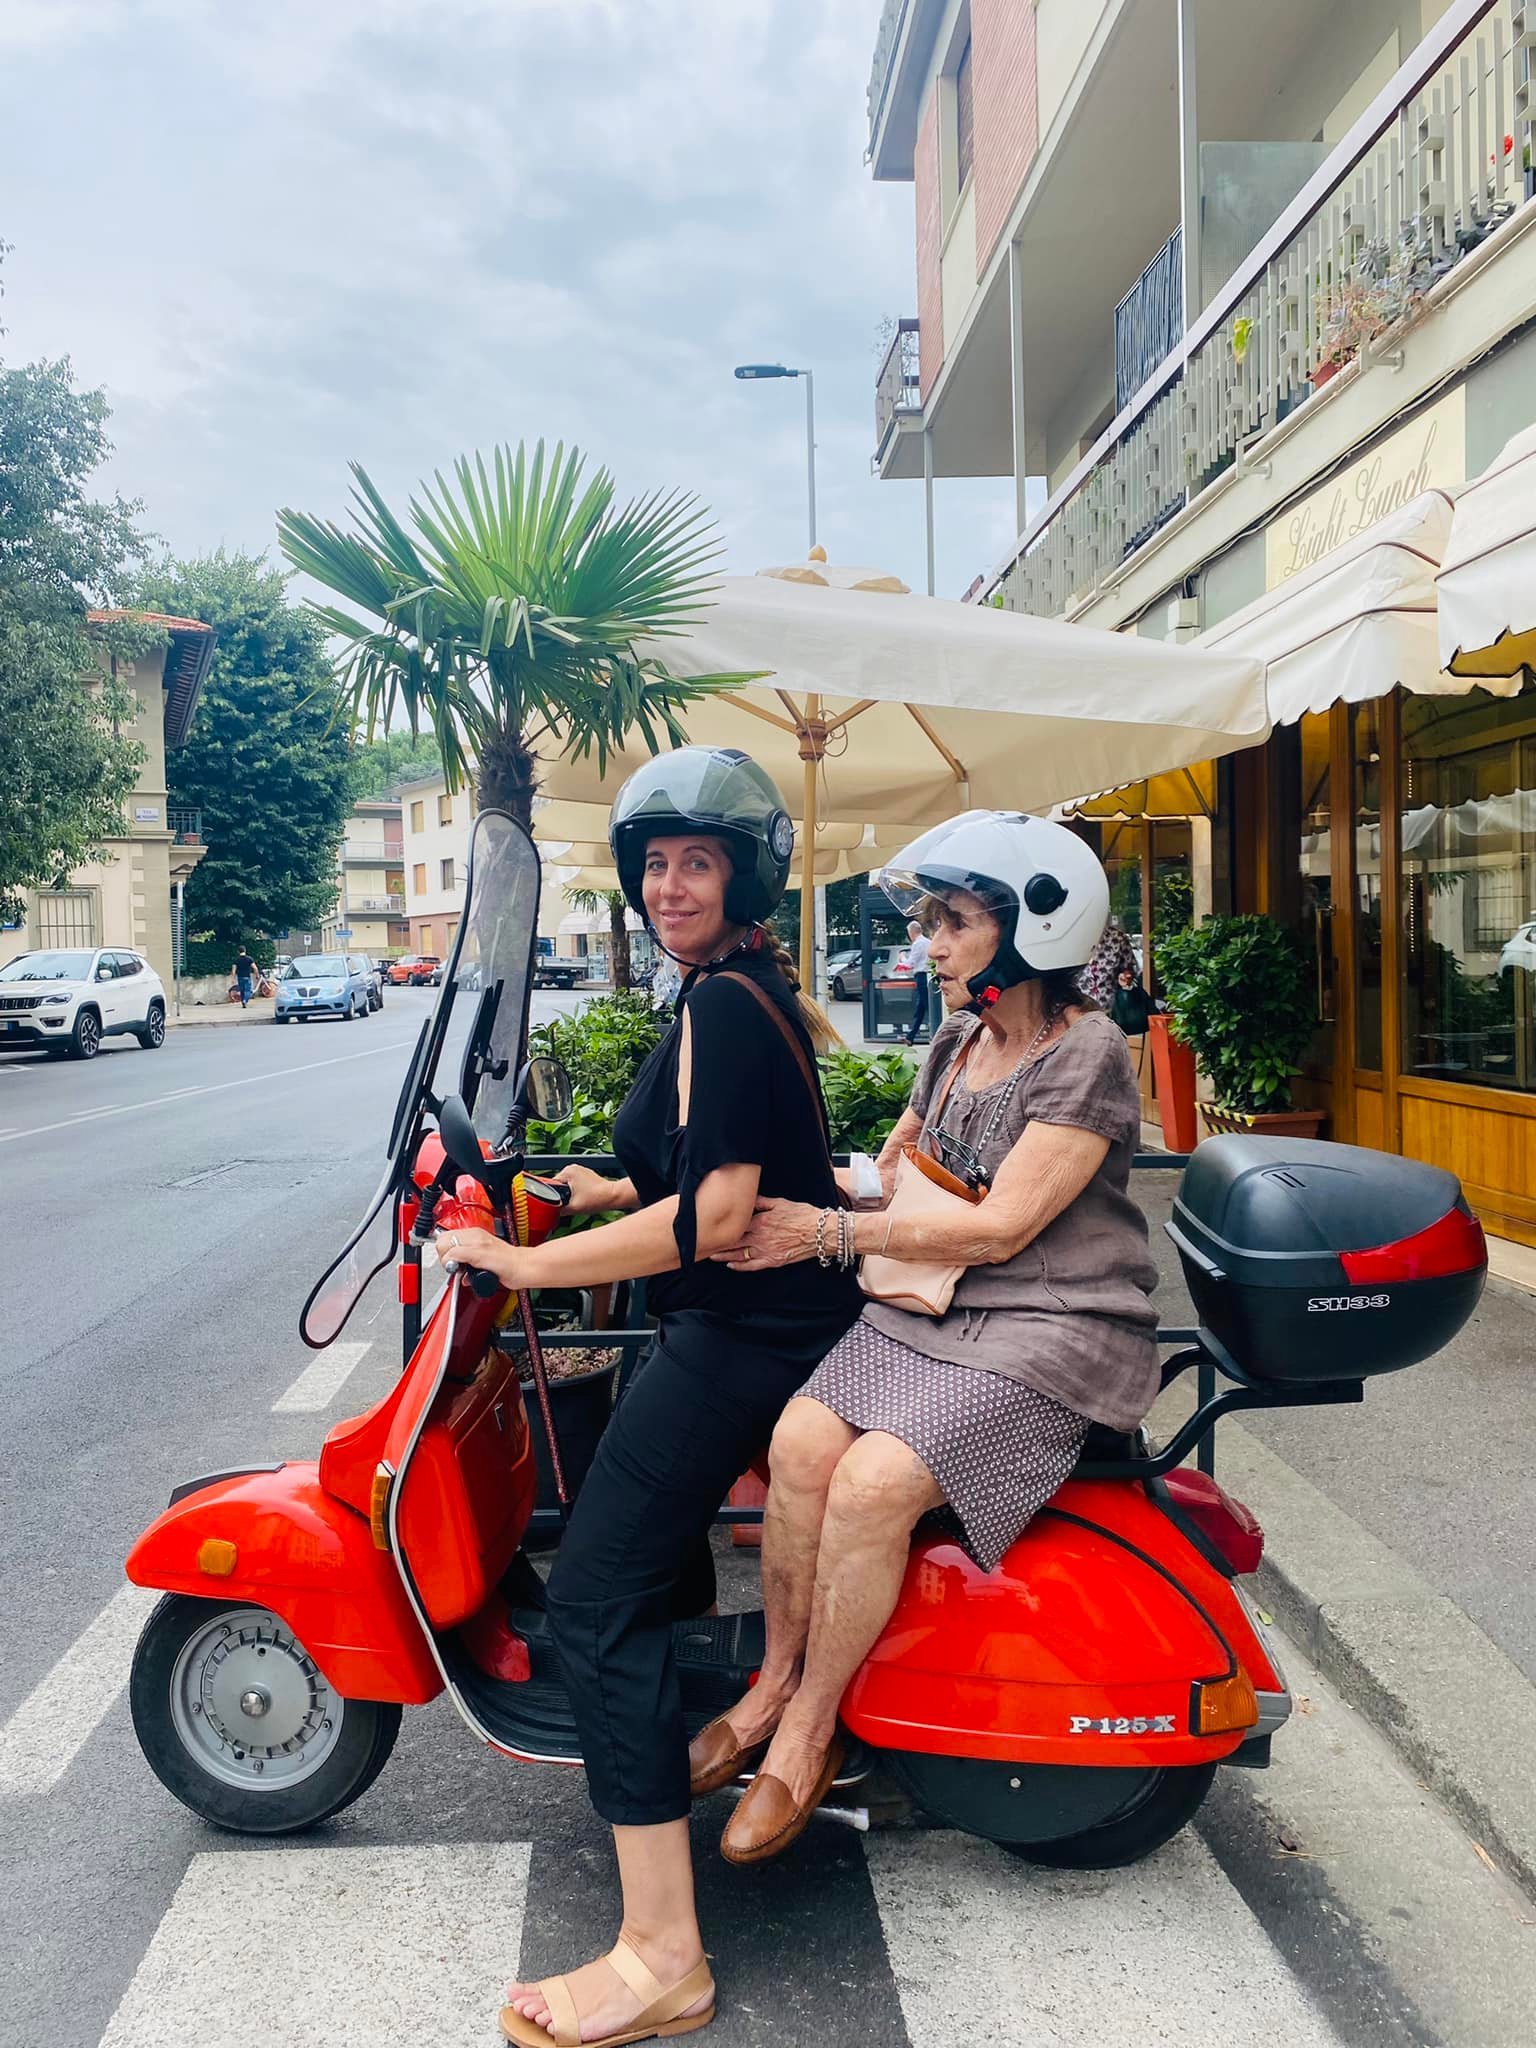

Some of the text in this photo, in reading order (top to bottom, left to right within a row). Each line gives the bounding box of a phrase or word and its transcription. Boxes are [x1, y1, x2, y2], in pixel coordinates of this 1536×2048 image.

[1349, 420, 1437, 537] Lunch
[1307, 1294, 1391, 1312] SH33
[1069, 1714, 1177, 1734] P 125 X
